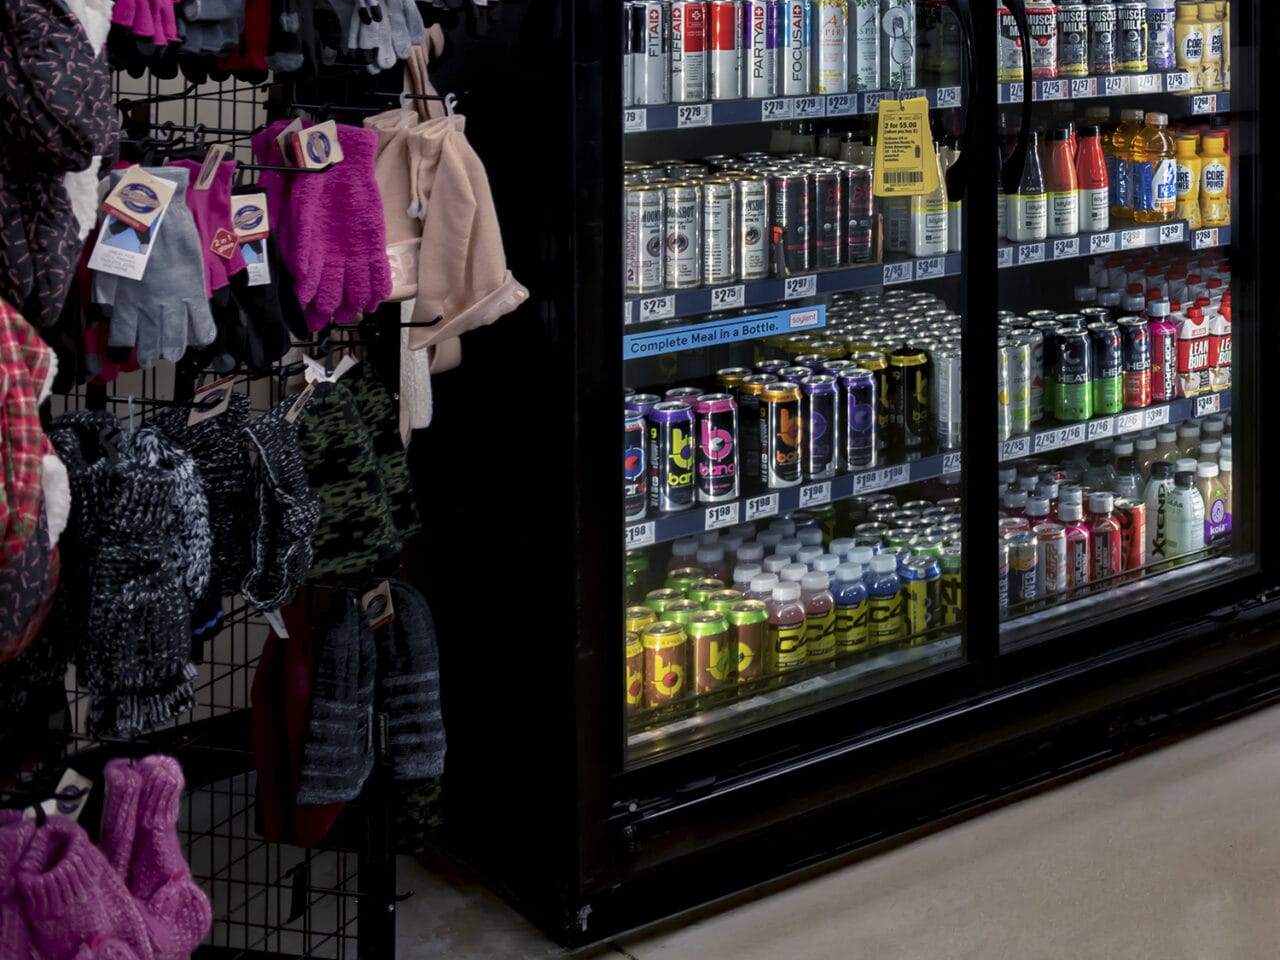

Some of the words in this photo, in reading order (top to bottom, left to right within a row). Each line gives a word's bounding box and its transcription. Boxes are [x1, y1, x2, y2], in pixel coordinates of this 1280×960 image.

[1119, 11, 1145, 23] MUSCLE
[648, 8, 660, 57] FITAID
[672, 7, 682, 62] LIFEAID
[753, 5, 765, 79] PARTYAID
[792, 4, 803, 82] FOCUSAID
[1168, 72, 1184, 86] 2/$5
[1044, 80, 1060, 94] 2/$5
[938, 89, 956, 102] 2/$5
[680, 105, 702, 121] $279
[765, 99, 785, 114] $279
[797, 98, 816, 113] $279
[1206, 169, 1225, 180] CORE
[1206, 180, 1225, 190] POWER
[1162, 226, 1179, 240] $399
[885, 265, 904, 278] 2/$5
[787, 278, 808, 292] $297
[715, 287, 737, 302] $275
[644, 297, 667, 312] $275
[792, 312, 817, 326] soylent
[631, 336, 689, 355] Complete
[691, 331, 718, 346] Meal
[720, 329, 731, 341] in
[733, 329, 740, 338] a
[742, 321, 779, 337] Bottle.
[1189, 340, 1209, 354] LEAN
[1188, 353, 1208, 370] BODY
[1058, 372, 1087, 382] HEAT
[1061, 428, 1081, 444] 2/$6
[1089, 422, 1108, 437] 2/$6
[1004, 440, 1025, 456] 2/$5
[1036, 434, 1056, 449] 2/$5
[700, 462, 736, 480] bang
[804, 486, 824, 501] $198
[750, 496, 771, 511] $198
[709, 505, 731, 521] $198
